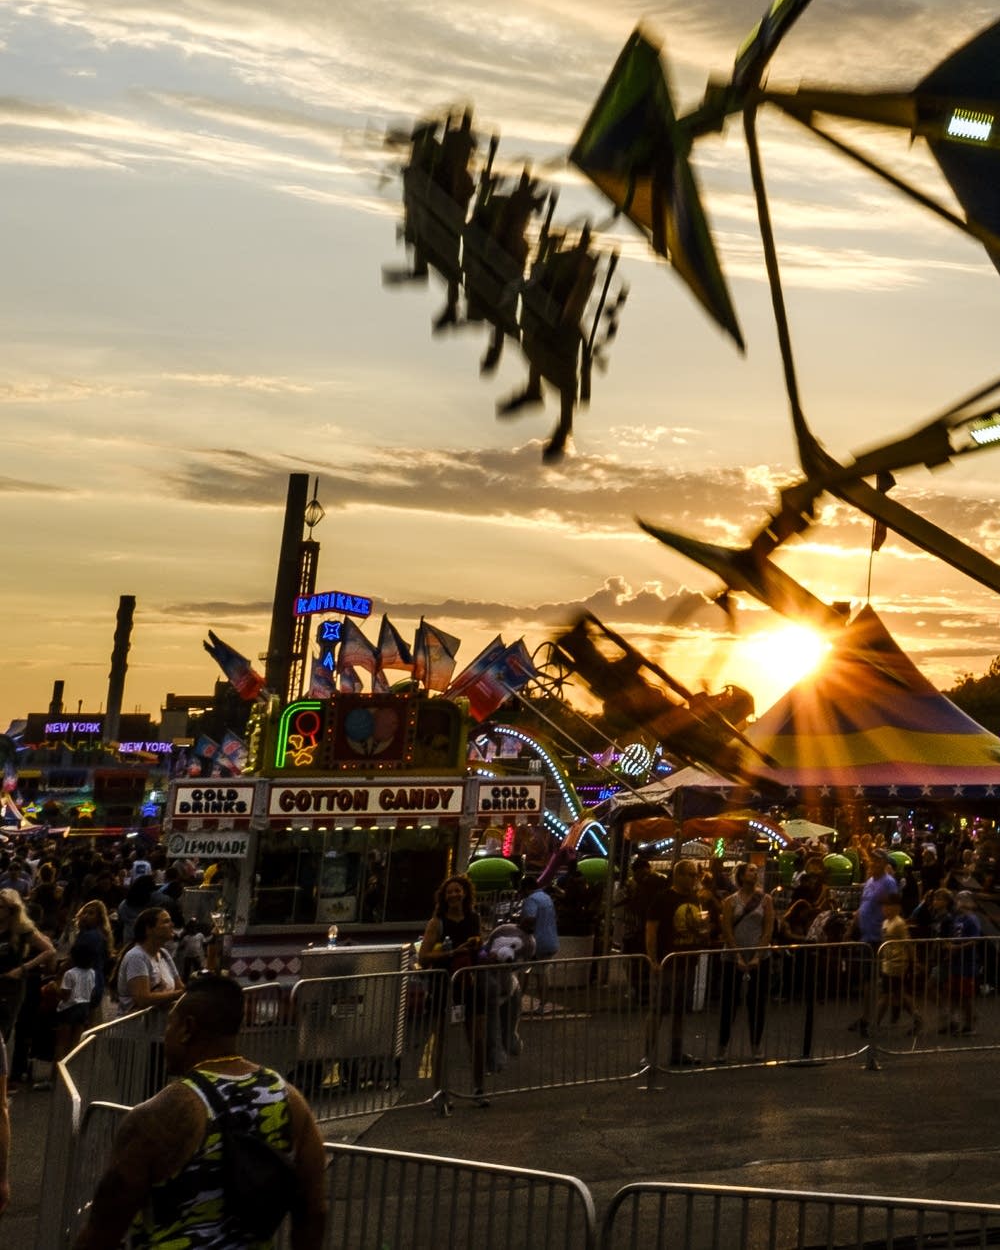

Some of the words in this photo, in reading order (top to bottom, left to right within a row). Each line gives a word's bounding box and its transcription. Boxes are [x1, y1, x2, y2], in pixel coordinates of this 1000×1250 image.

[297, 593, 370, 614] KAMIKAZE
[45, 722, 70, 733] NEW
[72, 722, 100, 732] YORK
[118, 742, 143, 753] NEW
[145, 741, 173, 753] YORK
[191, 789, 239, 801] COLD
[491, 787, 529, 798] COLD
[279, 790, 369, 812] COTTON
[379, 789, 454, 811] CANDY
[481, 798, 537, 810] DRINKS
[179, 801, 247, 813] DRINKS
[184, 840, 246, 854] LEMONADE
